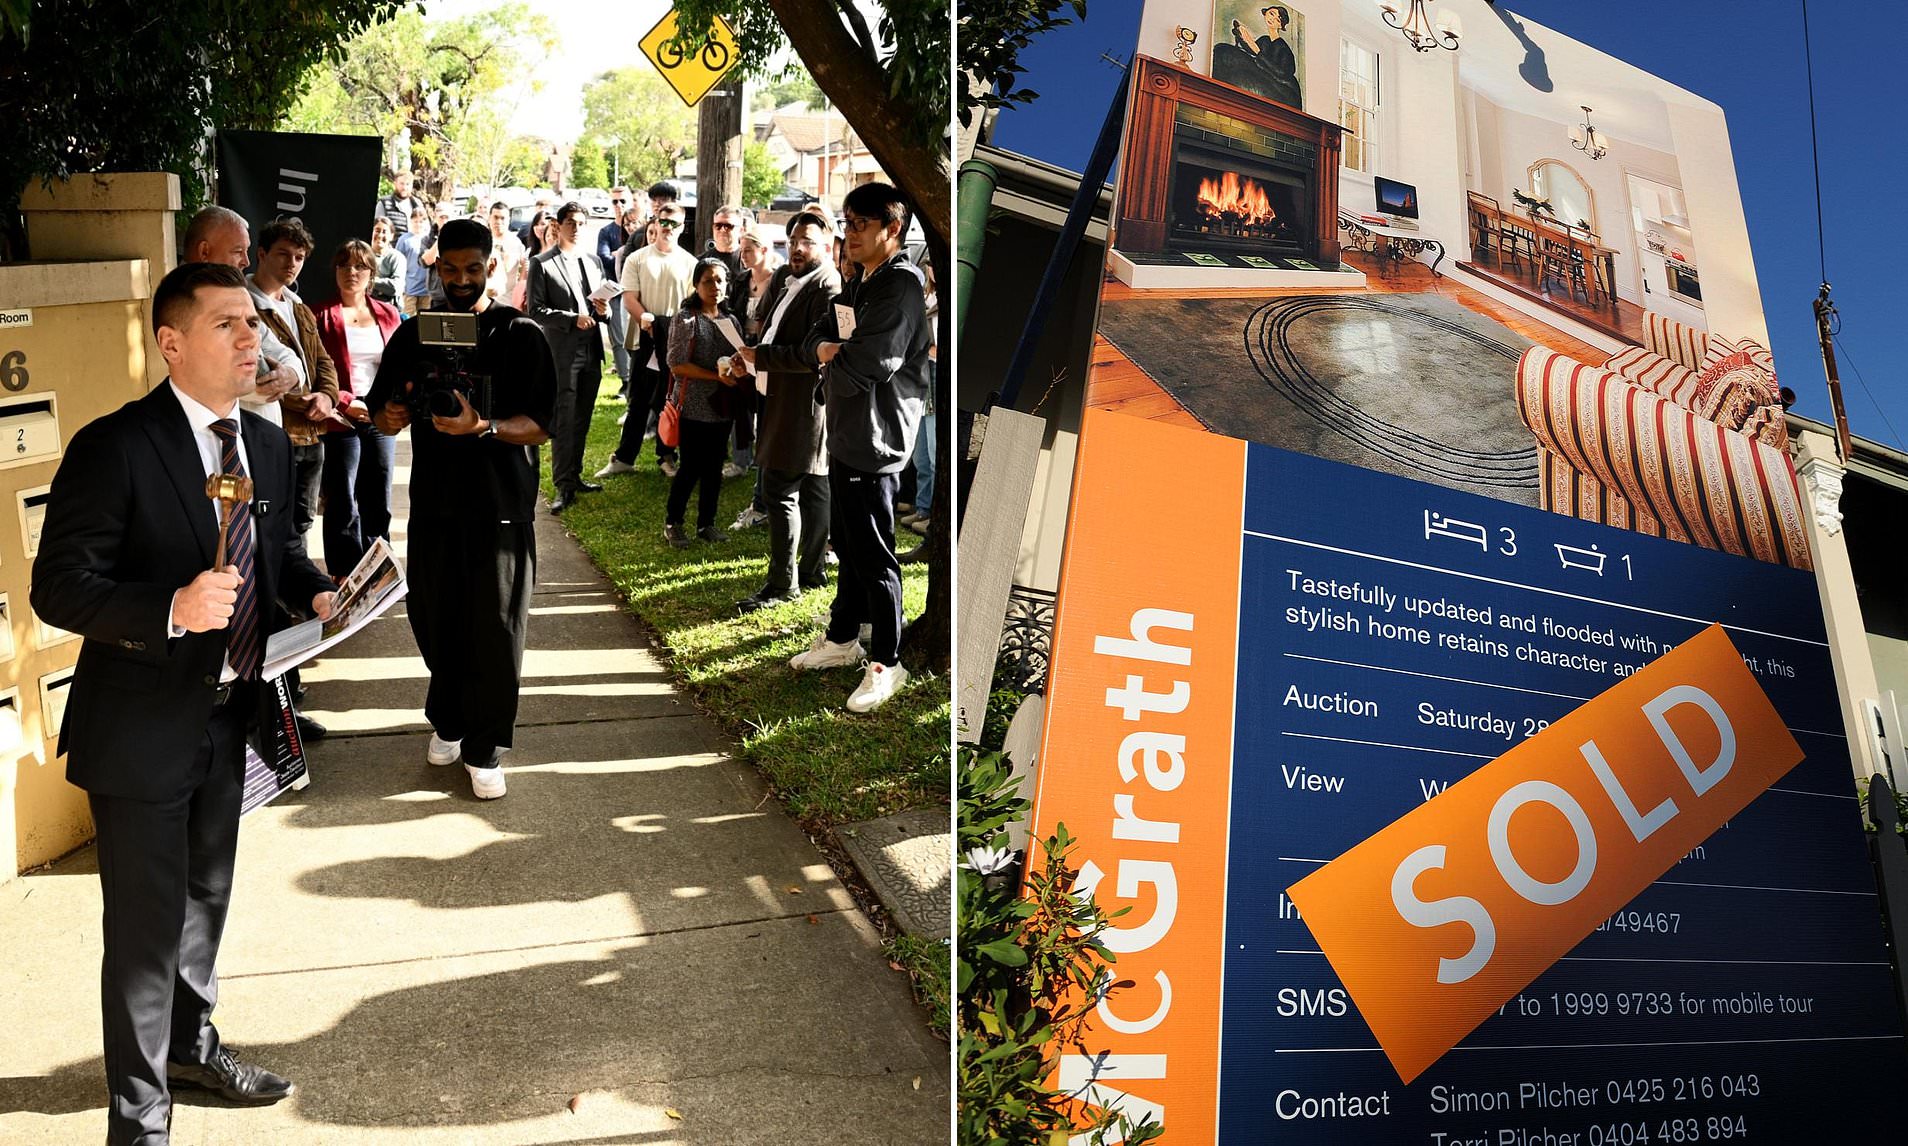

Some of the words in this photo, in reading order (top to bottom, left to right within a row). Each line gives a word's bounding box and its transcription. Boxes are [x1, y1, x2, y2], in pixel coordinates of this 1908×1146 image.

[0, 313, 29, 324] Room
[0, 351, 30, 392] 6
[17, 429, 24, 441] 2
[1499, 527, 1518, 557] 3
[1621, 554, 1633, 581] 1
[1285, 606, 1360, 633] stylish
[1368, 615, 1431, 644] home
[1438, 632, 1509, 658] retains
[1515, 642, 1608, 674] character
[1613, 662, 1646, 677] an
[1286, 569, 1397, 613] Tastefully
[1404, 596, 1493, 625] updated
[1499, 614, 1537, 633] and
[1542, 617, 1615, 647] flooded
[1619, 633, 1657, 655] with
[1767, 658, 1796, 678] this
[1283, 684, 1379, 718] Auction
[1417, 702, 1516, 741] Saturday
[1281, 764, 1345, 793] View
[1391, 684, 1737, 984] SOLD
[1276, 988, 1347, 1017] SMS
[1518, 994, 1541, 1016] to
[1551, 992, 1609, 1016] 1999
[1616, 992, 1673, 1015] 9733
[1679, 993, 1706, 1014] for
[1712, 992, 1774, 1014] mobile
[1778, 993, 1814, 1013] tour
[1275, 1089, 1390, 1120] Contact
[1430, 1085, 1510, 1113] Simon
[1519, 1081, 1599, 1109] Pilcher
[1606, 1079, 1665, 1104] 0425
[1673, 1076, 1714, 1101] 216
[1720, 1074, 1760, 1098] 043
[1589, 1121, 1650, 1146] 0404
[1658, 1118, 1700, 1144] 483
[1706, 1115, 1747, 1140] 894
